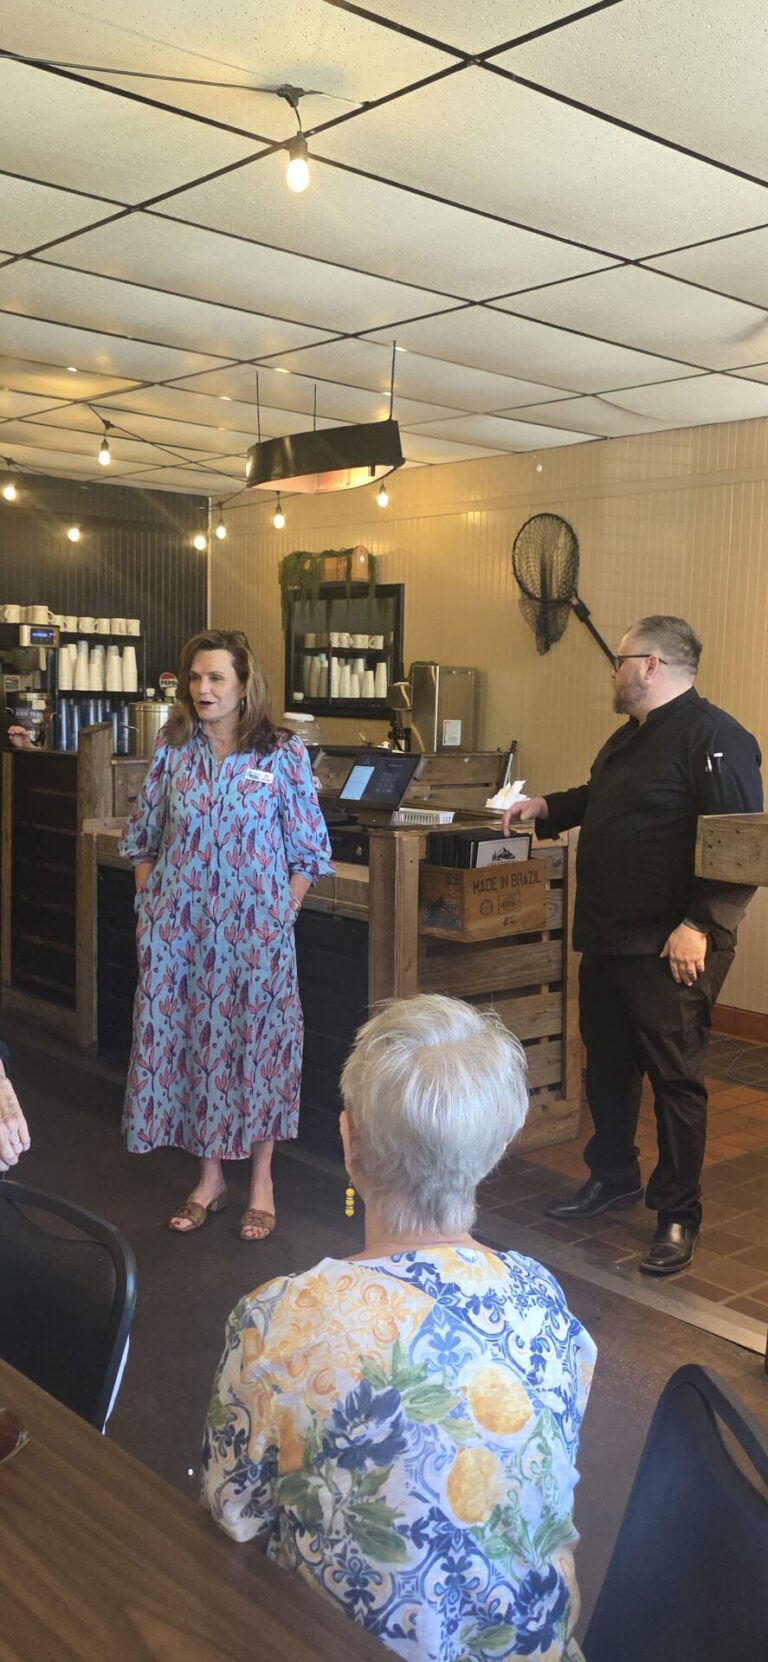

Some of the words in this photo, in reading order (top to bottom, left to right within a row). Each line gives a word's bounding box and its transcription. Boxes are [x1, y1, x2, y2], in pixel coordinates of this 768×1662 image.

[472, 876, 498, 894] MADE
[500, 874, 509, 889] IN
[511, 870, 542, 888] BRAZIL
